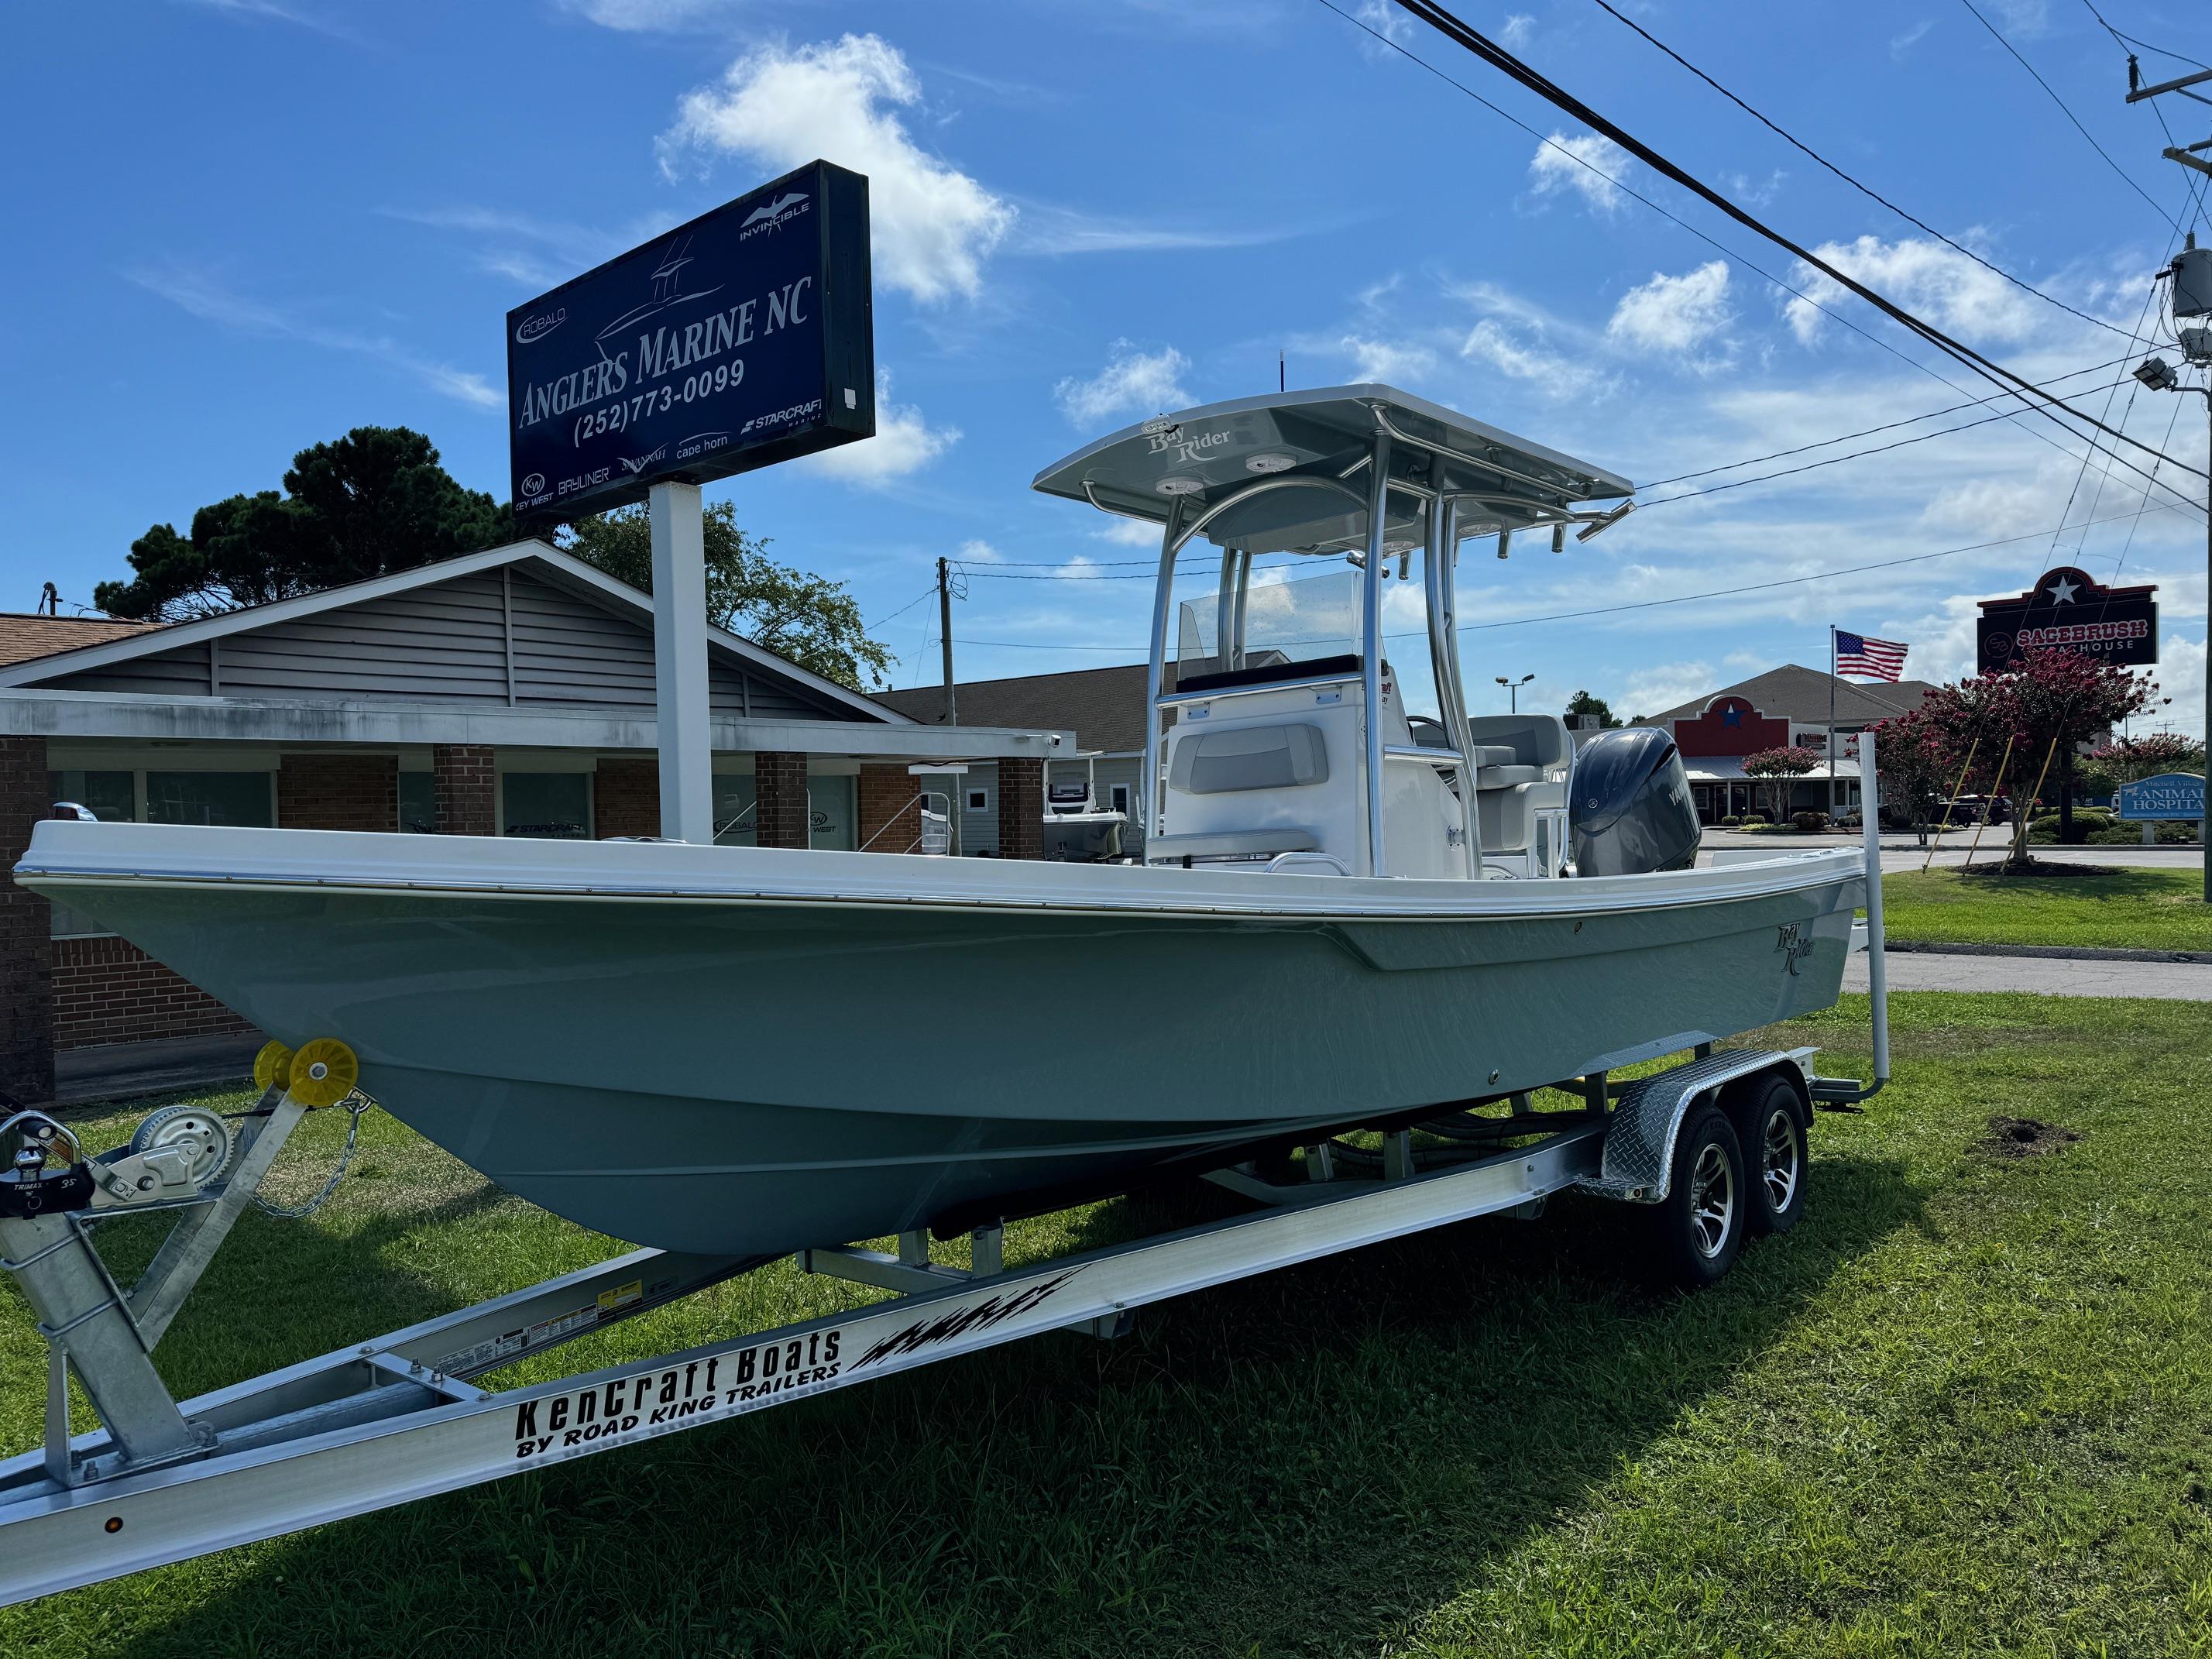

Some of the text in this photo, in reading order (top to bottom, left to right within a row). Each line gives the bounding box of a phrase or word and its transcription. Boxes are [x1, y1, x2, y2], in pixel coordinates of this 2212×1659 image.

[740, 202, 810, 242] INVINCIBLE
[523, 307, 565, 337] ROBALO
[518, 276, 812, 429] ANGLERS MARINE NC
[574, 359, 744, 448] (252)773-0099
[755, 398, 822, 429] STARCRAFT
[676, 435, 728, 459] cape horn
[1142, 427, 1184, 455] Bay
[1170, 431, 1230, 463] Rider
[525, 478, 542, 493] KW
[558, 467, 610, 496] BAYLINER
[531, 493, 554, 507] WEST
[2017, 620, 2148, 647] SAGEBRUSH
[2133, 799, 2206, 810] HOSPITA
[14, 1178, 77, 1191] TRIMAX 35
[515, 1331, 841, 1441] KenCraft Boats
[517, 1362, 842, 1458] BY ROAD KING TRAILERS
